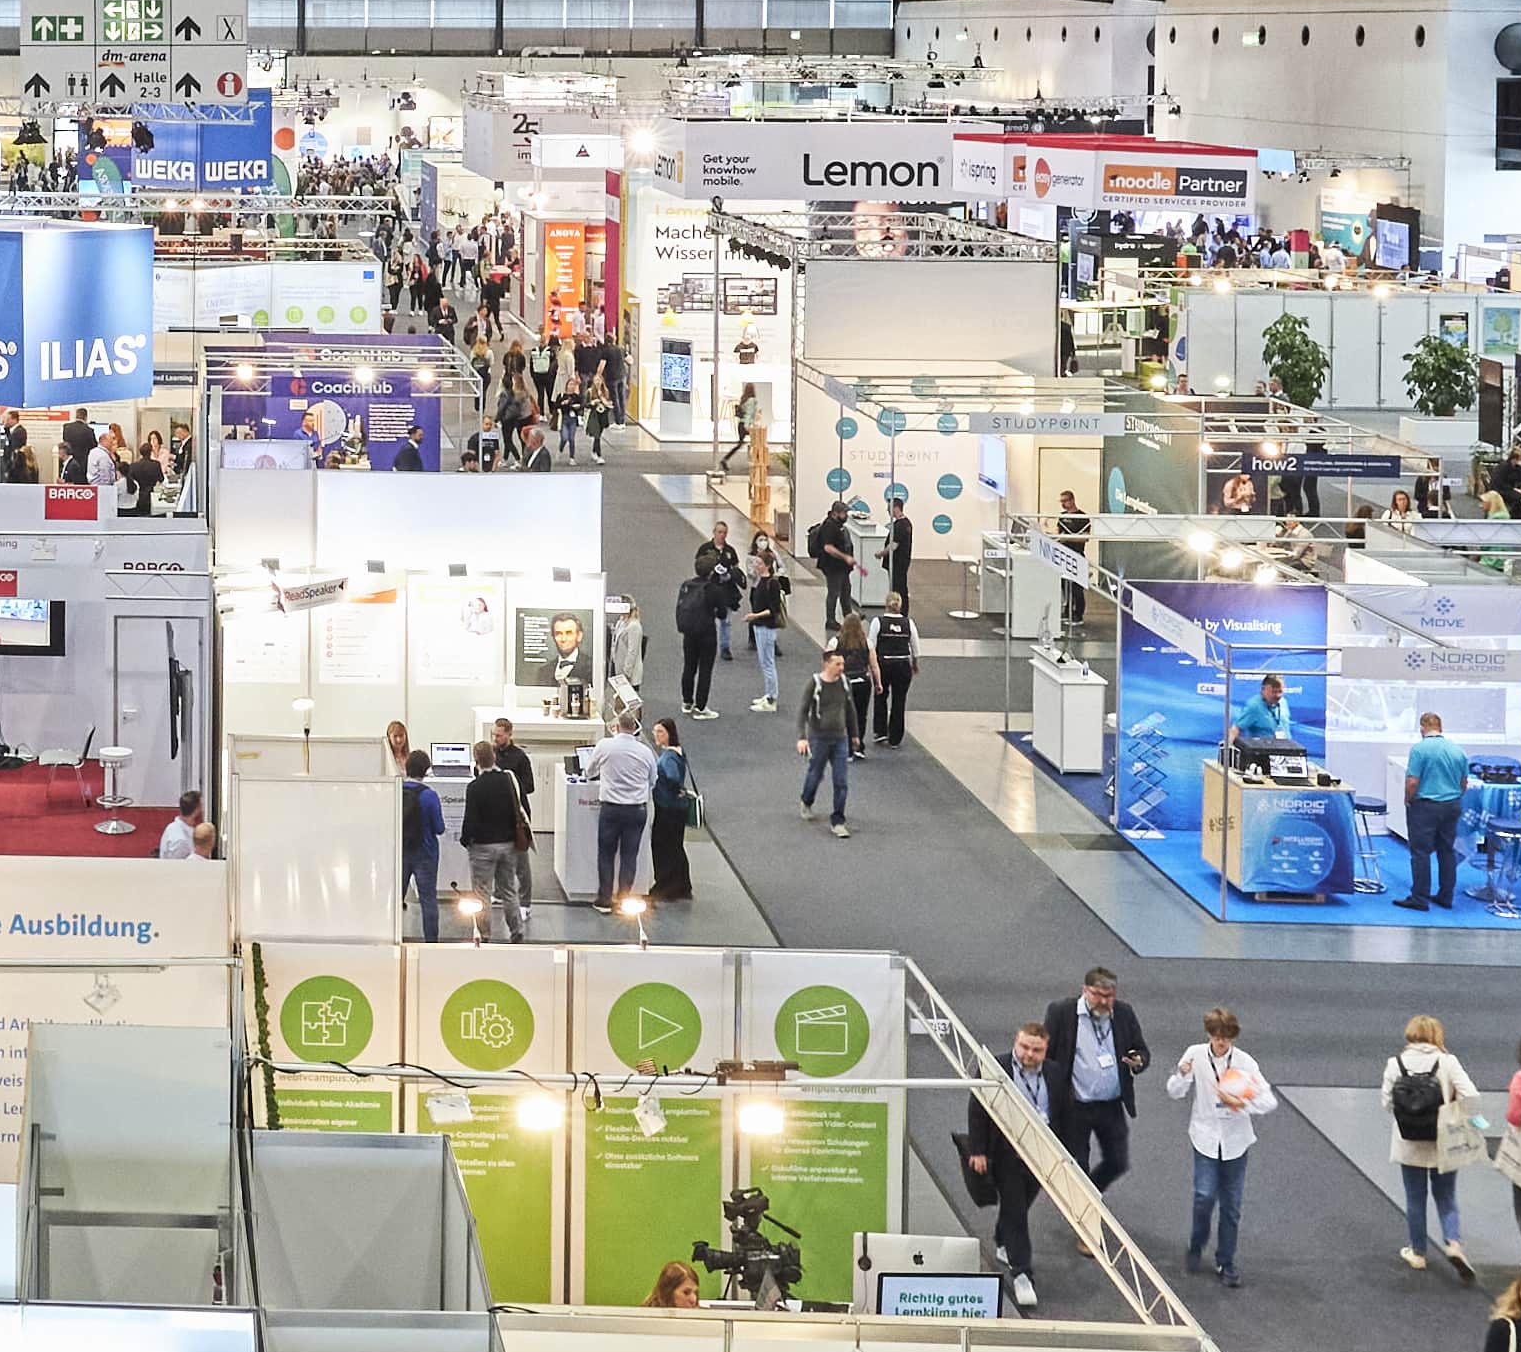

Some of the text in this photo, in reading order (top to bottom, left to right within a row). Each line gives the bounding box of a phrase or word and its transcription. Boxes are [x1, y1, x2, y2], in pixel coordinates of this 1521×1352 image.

[102, 49, 166, 63] dm-arena
[134, 72, 167, 83] Halle
[140, 87, 161, 98] 2-3
[703, 155, 750, 167] Get your
[136, 159, 267, 181] WEKA WEKA
[702, 165, 757, 175] knowhow
[803, 154, 939, 187] Lemon
[1108, 171, 1172, 191] moodle
[1179, 175, 1244, 194] Partner
[1103, 196, 1246, 208] CERTIFIED SERVICES PROVIDER
[1252, 457, 1297, 472] how2
[49, 488, 95, 501] BARCO
[1222, 618, 1282, 635] Visualising
[1430, 651, 1505, 666] NORDIC
[8, 915, 161, 944] Ausbildung.
[899, 1292, 984, 1307] Richtig gutes
